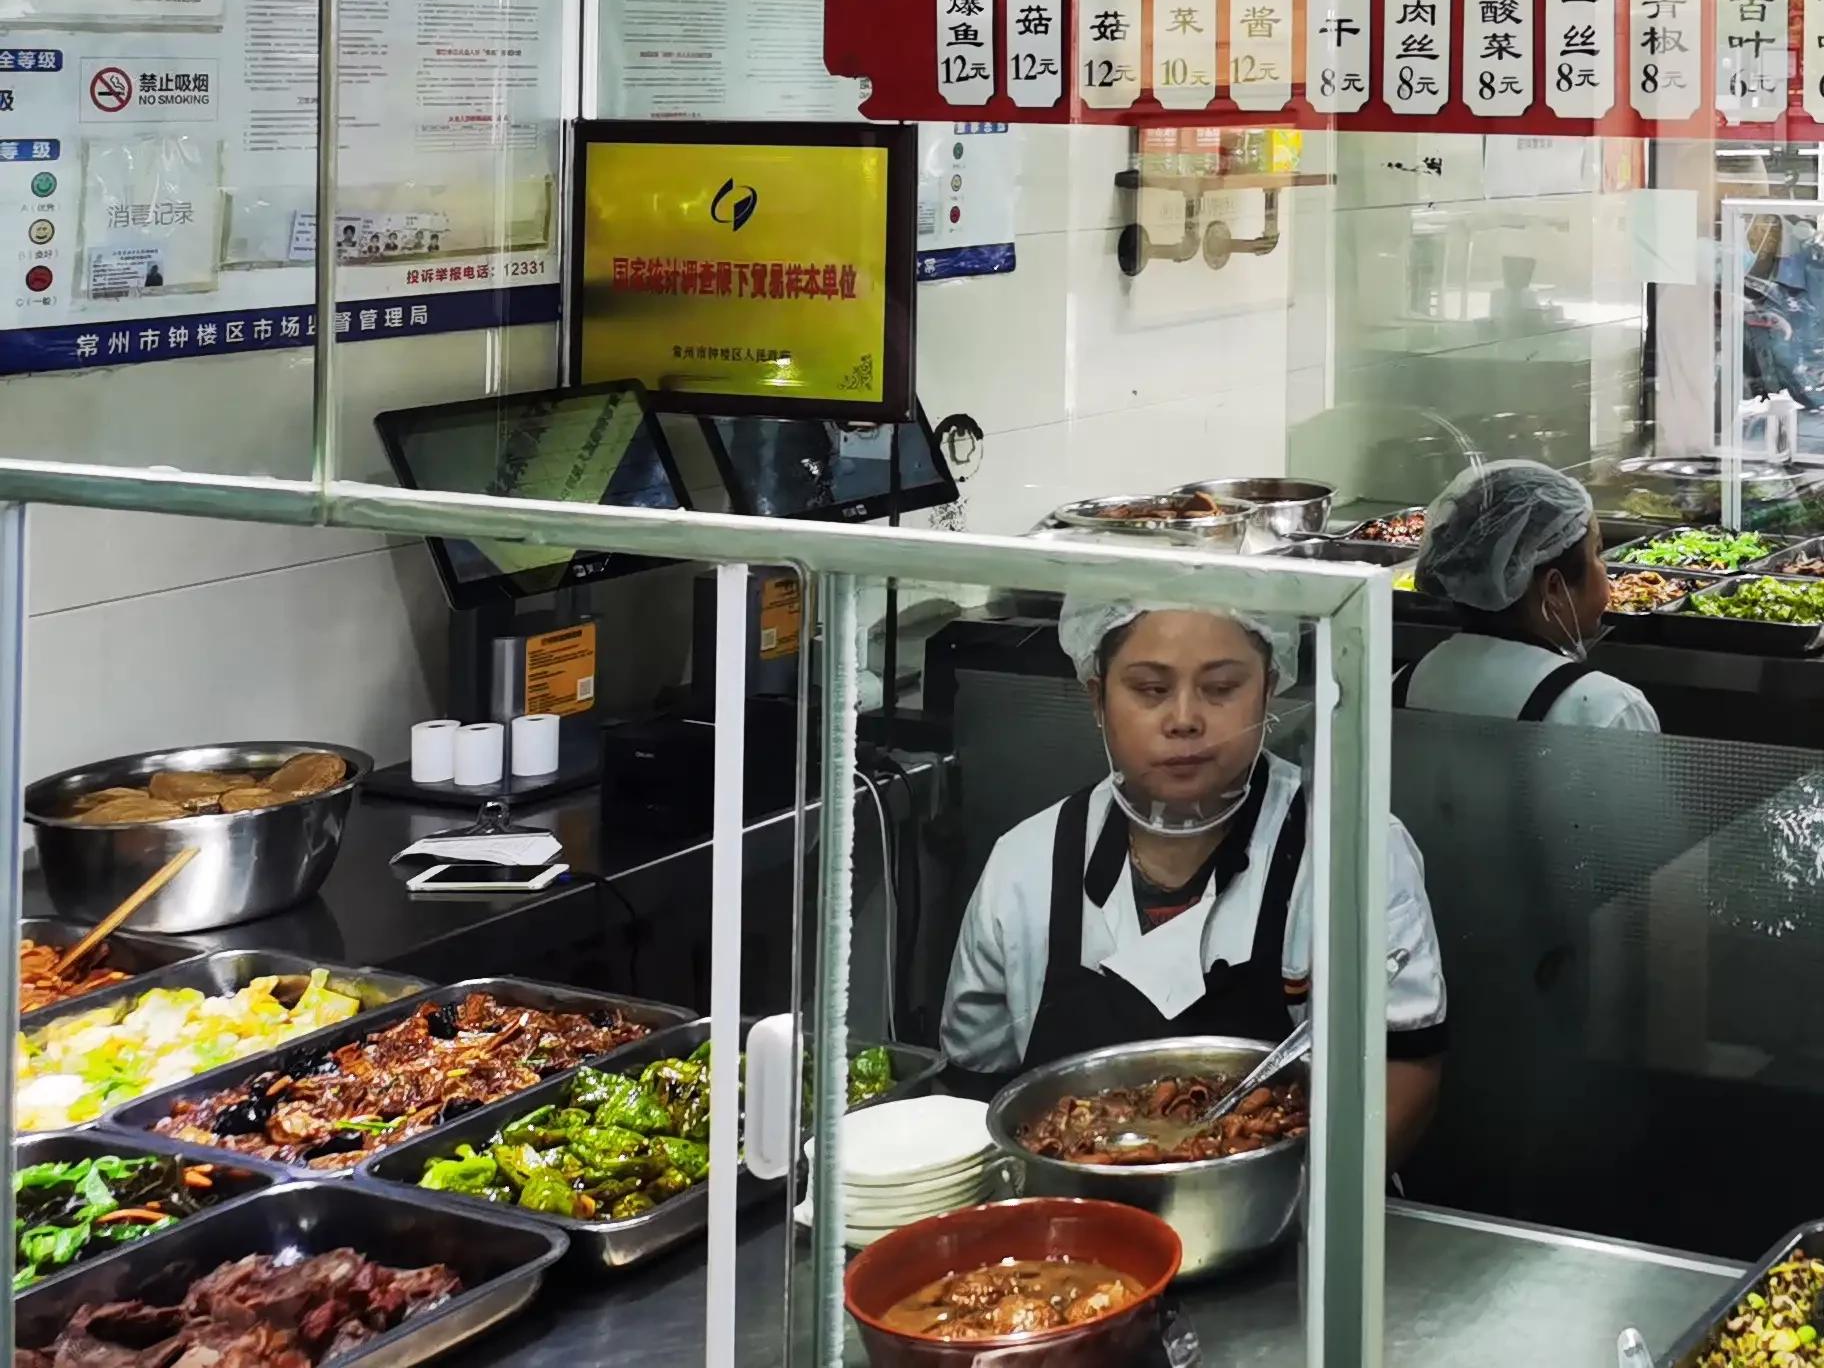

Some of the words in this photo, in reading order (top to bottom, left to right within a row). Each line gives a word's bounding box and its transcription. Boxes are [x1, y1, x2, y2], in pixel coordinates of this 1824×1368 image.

[940, 56, 991, 85] 12元
[1010, 53, 1059, 81] 12元
[1084, 59, 1138, 89] 12元
[1160, 58, 1211, 87] 10元
[1230, 54, 1284, 85] 12元
[1320, 66, 1365, 97] 8元
[1555, 62, 1599, 92] 8元
[1640, 63, 1688, 95] 8元
[139, 73, 209, 93] 禁止吸烟
[1397, 65, 1439, 101] 8元
[1478, 69, 1523, 100] 8元
[138, 95, 156, 105] NO
[158, 94, 209, 105] SMOKING
[107, 202, 195, 229] 消毒记录
